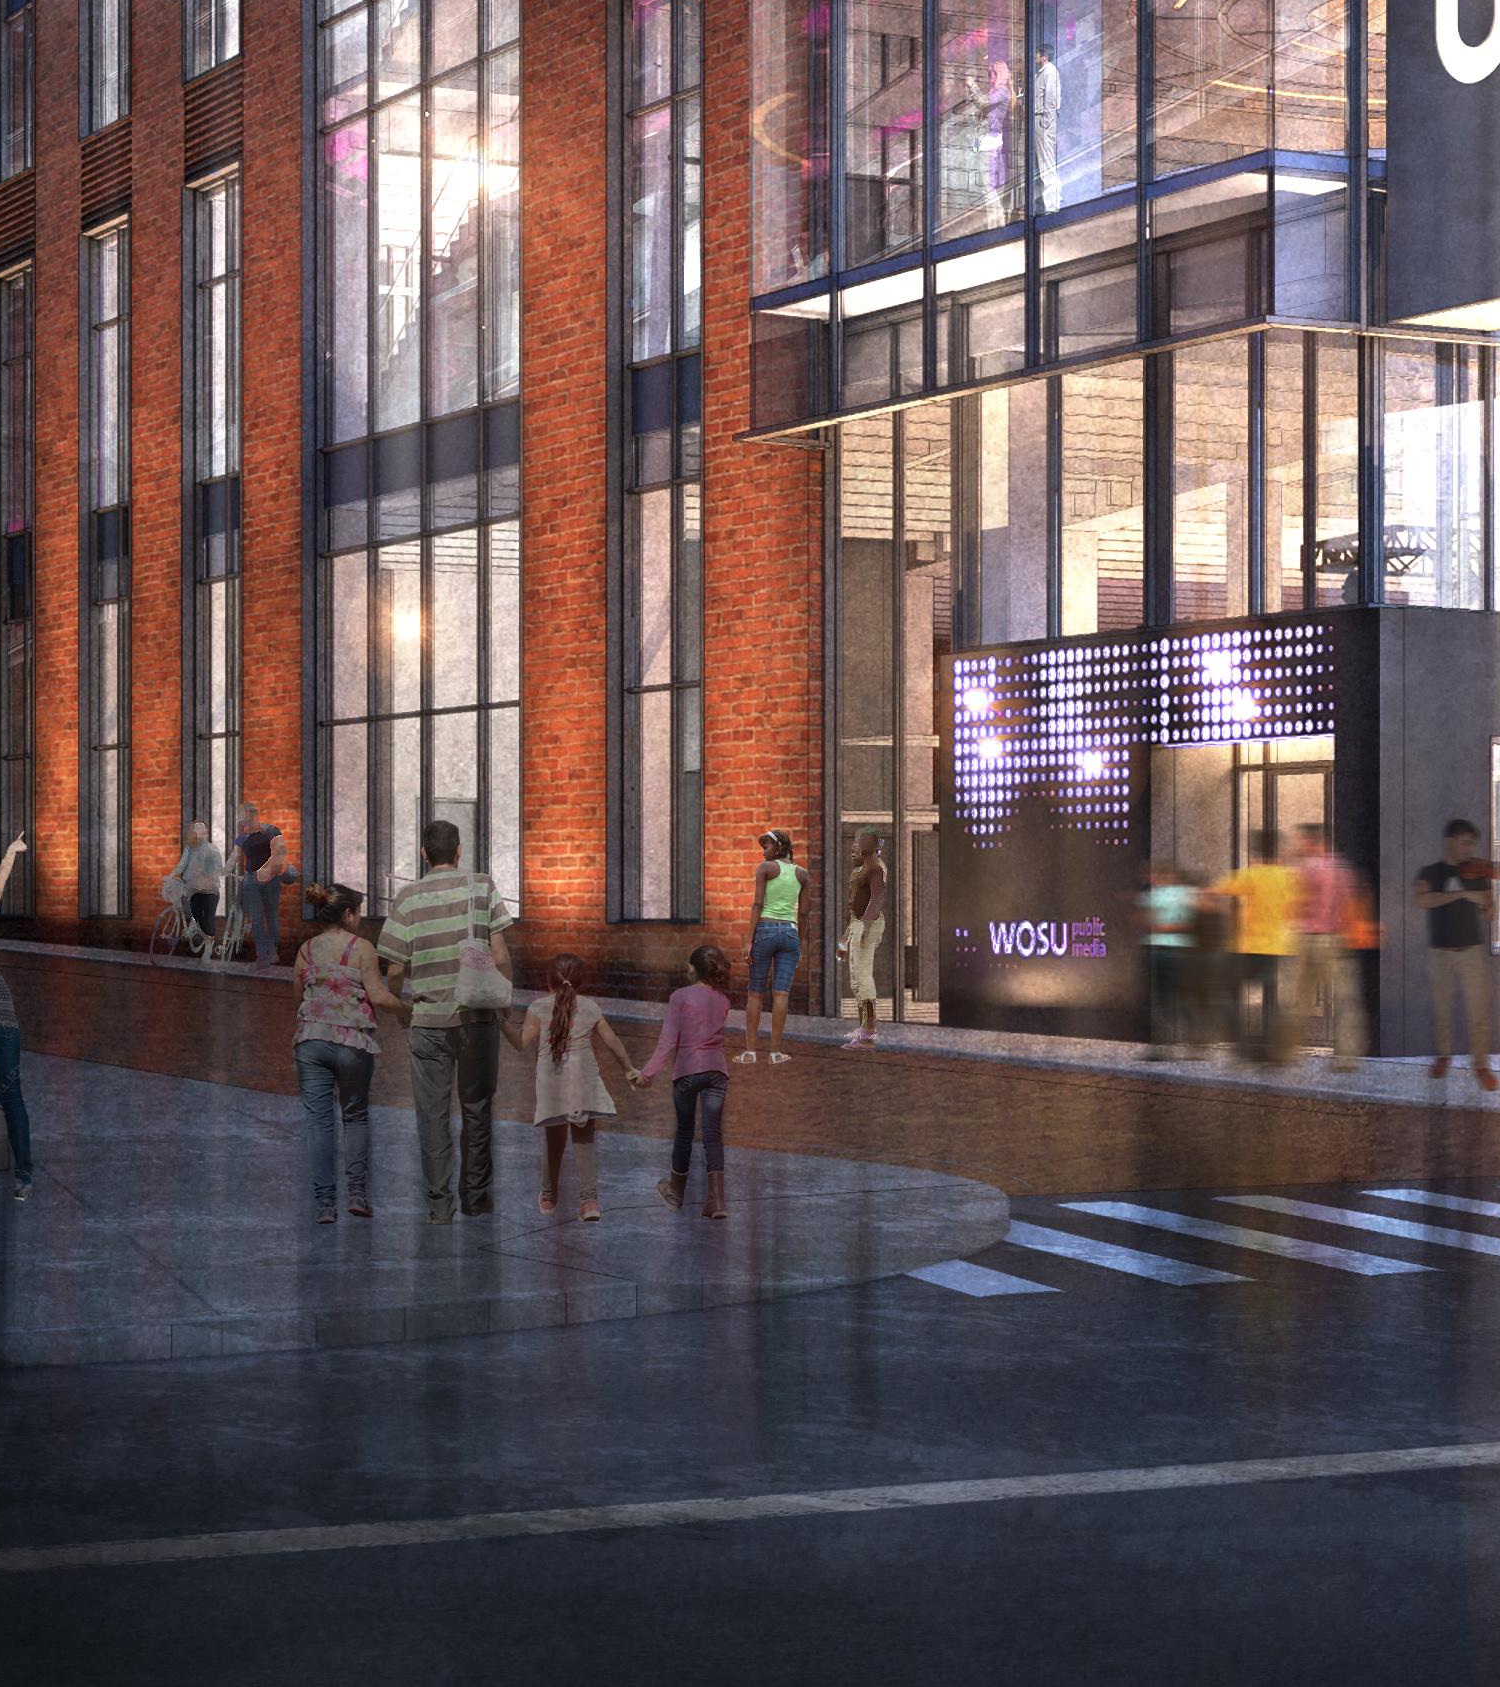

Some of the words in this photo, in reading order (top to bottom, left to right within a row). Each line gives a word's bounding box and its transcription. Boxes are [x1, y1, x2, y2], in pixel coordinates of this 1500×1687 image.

[988, 919, 1069, 957] WOSU
[1071, 916, 1106, 941] public
[1071, 938, 1107, 958] media
